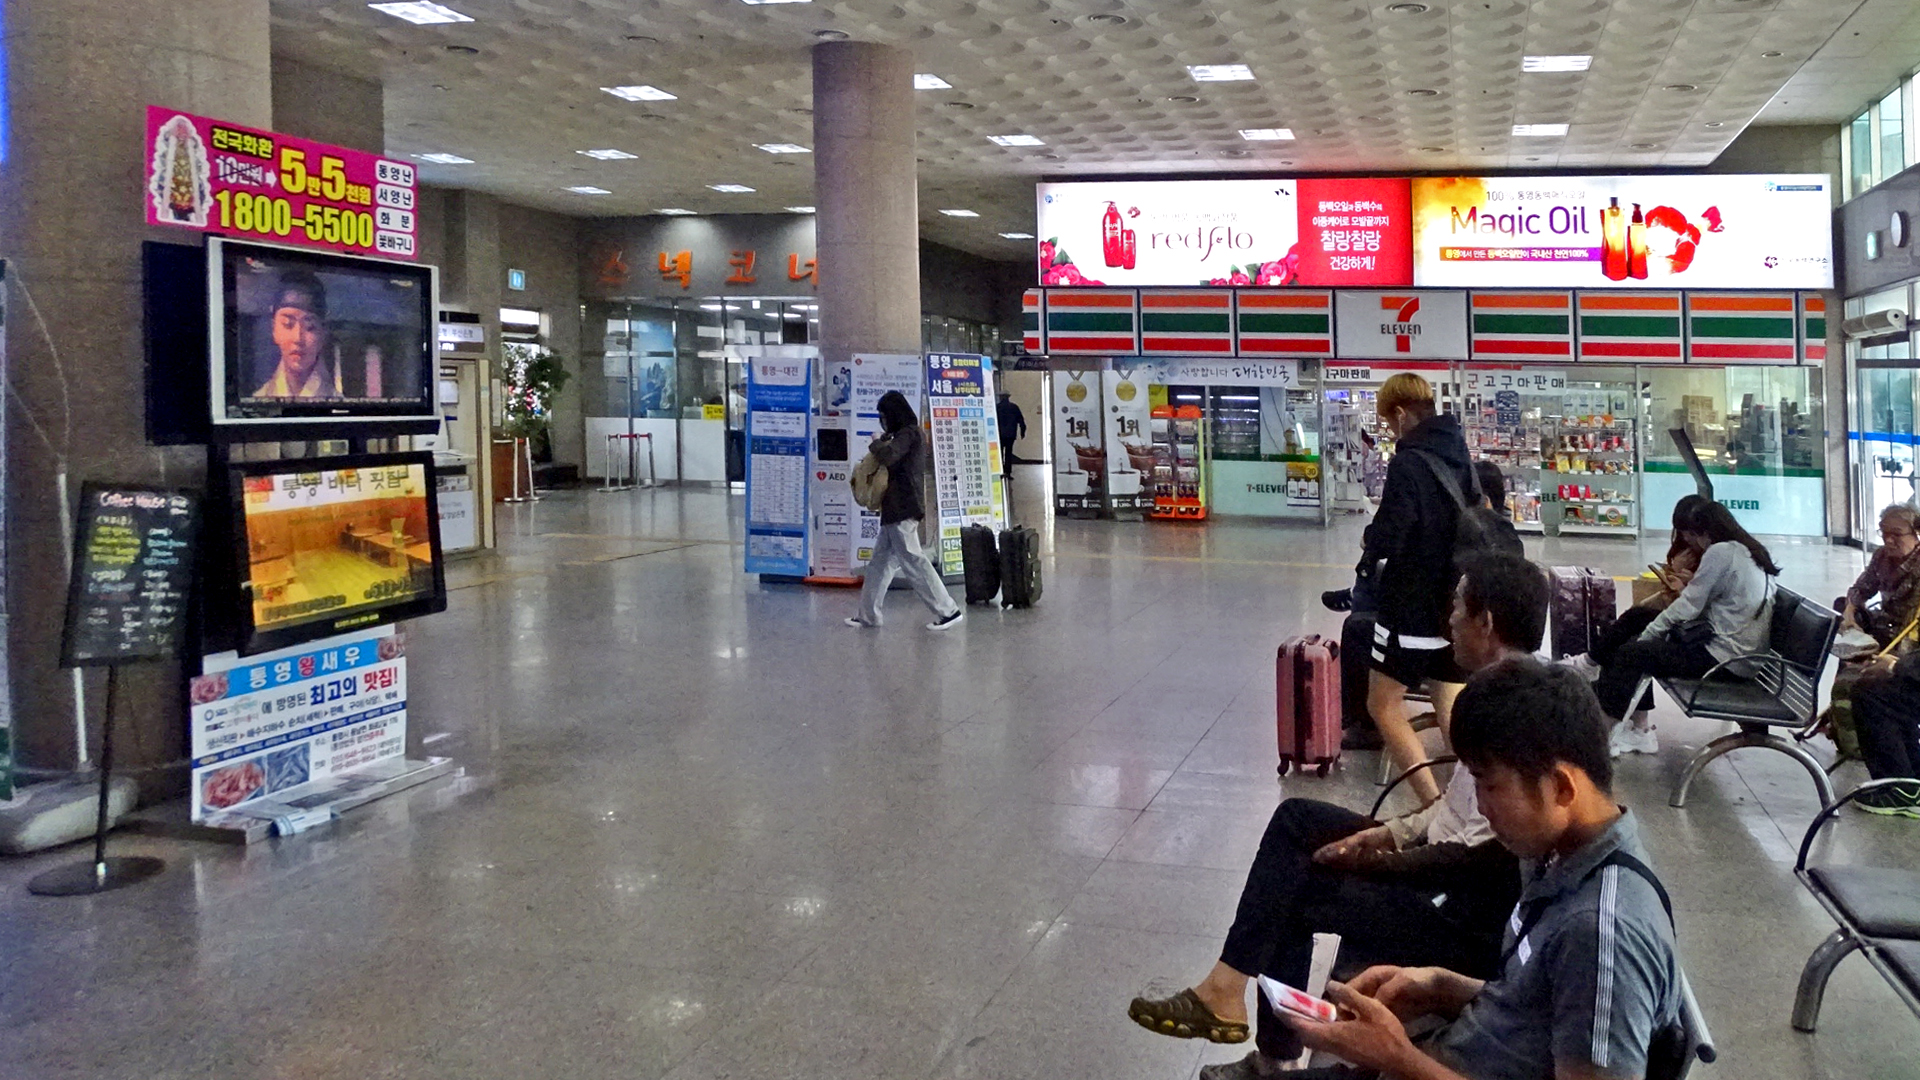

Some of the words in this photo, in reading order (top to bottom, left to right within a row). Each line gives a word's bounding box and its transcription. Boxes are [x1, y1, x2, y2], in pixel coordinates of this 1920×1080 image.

[212, 127, 274, 159] 전국화환
[215, 189, 374, 248] 1800-5500
[1450, 206, 1541, 239] Magic
[1549, 206, 1590, 234] Oil
[1321, 230, 1382, 252] 찰랑찰랑
[930, 355, 951, 369] 통영
[1180, 367, 1229, 378] 사랑합니다
[1232, 365, 1291, 383] 대한민국
[932, 379, 953, 394] 서울
[1066, 416, 1090, 439] 1위
[1116, 415, 1141, 438] 1위
[828, 472, 846, 481] AED
[310, 676, 357, 706] 최고의
[364, 667, 398, 693] 맛집!
